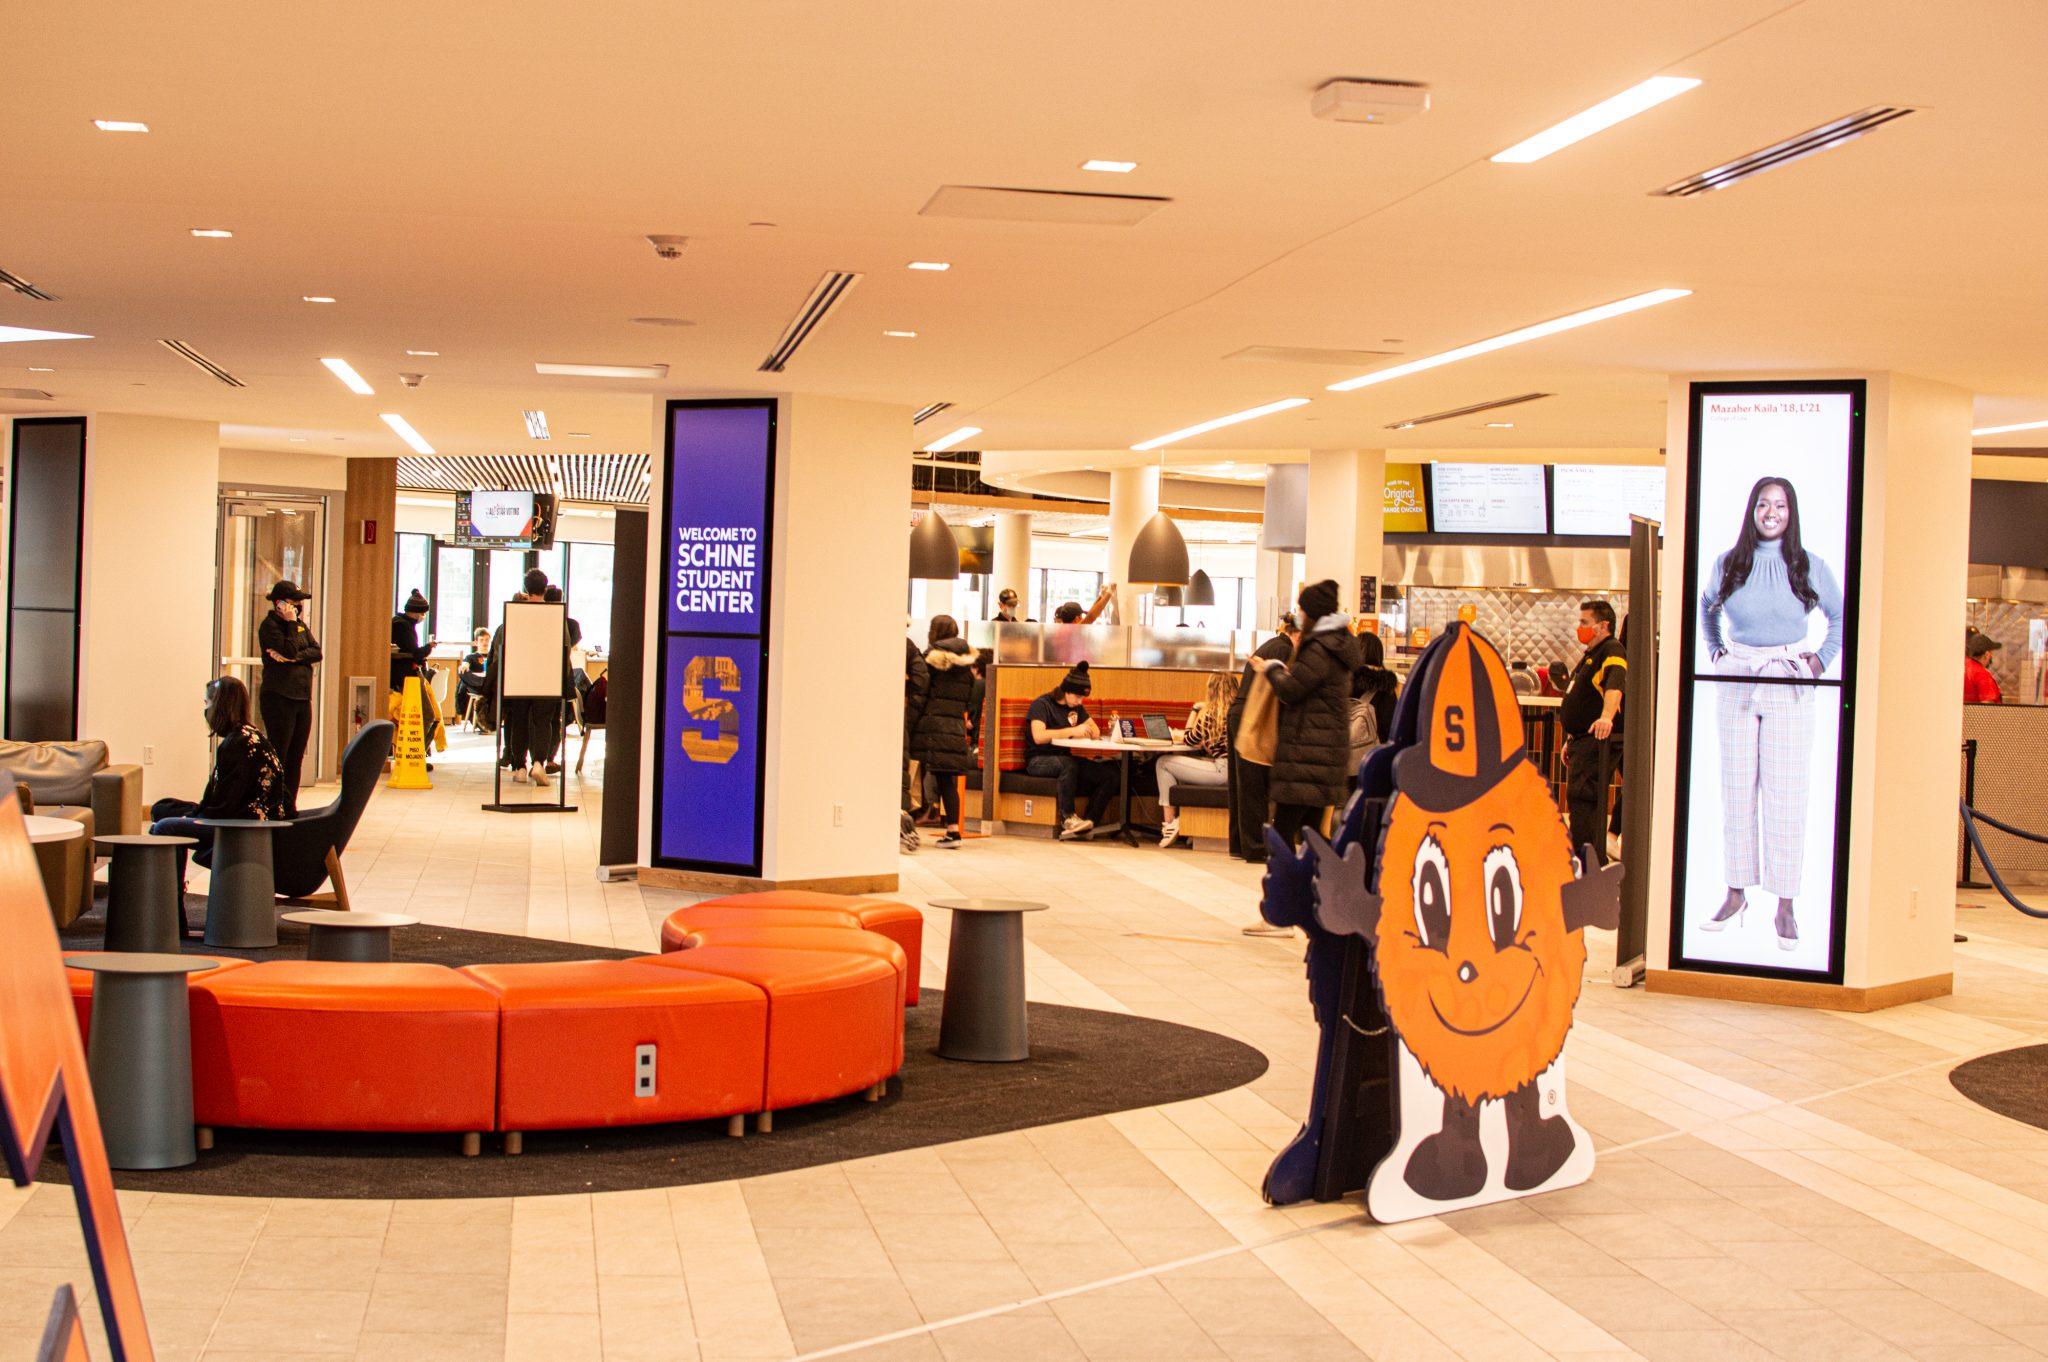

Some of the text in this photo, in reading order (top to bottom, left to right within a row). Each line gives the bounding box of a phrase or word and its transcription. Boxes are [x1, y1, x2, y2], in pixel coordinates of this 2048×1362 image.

[1710, 403, 1751, 413] Mazaher
[1754, 403, 1778, 413] Kaila
[1384, 487, 1415, 506] Original
[679, 527, 757, 542] WELCOME TO
[678, 543, 756, 568] SCHINE
[677, 569, 755, 590] STUDENT
[676, 589, 754, 614] CENTER
[681, 655, 741, 764] S
[1445, 705, 1465, 752] S
